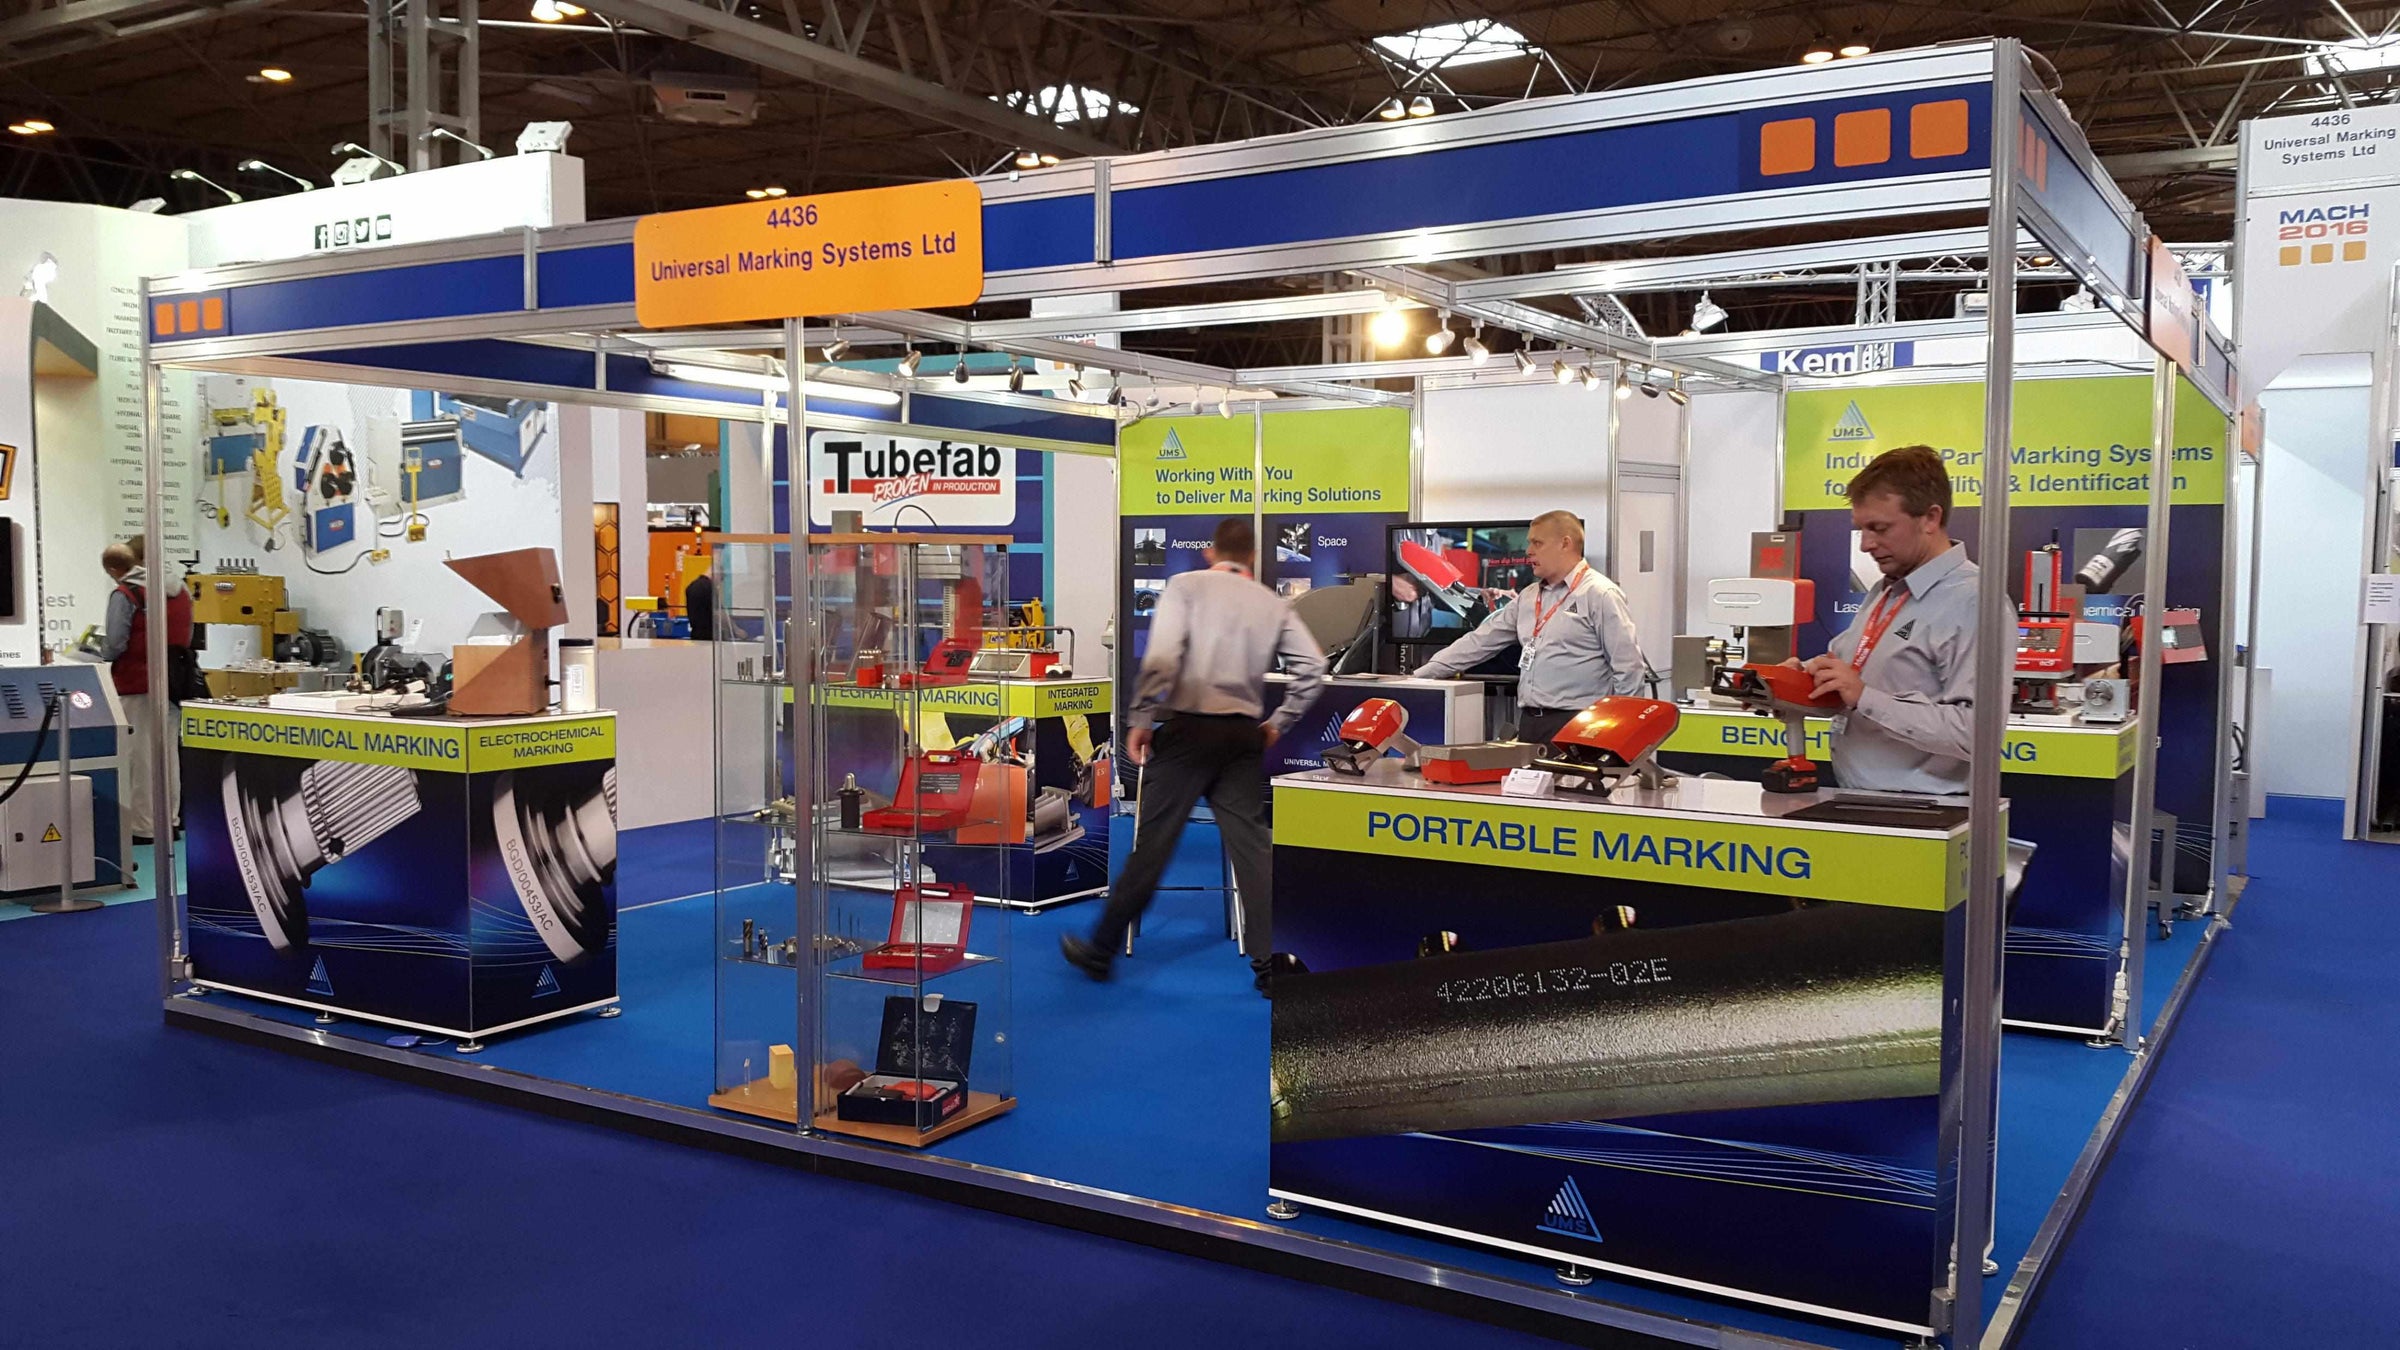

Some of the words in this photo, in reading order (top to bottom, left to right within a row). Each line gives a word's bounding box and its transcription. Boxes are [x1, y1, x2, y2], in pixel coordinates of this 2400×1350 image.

[2311, 114, 2351, 127] 4436
[2264, 134, 2330, 150] Universal
[2336, 128, 2396, 143] Marking
[2282, 149, 2346, 165] Systems
[2352, 144, 2376, 157] Ltd
[767, 204, 819, 229] 4436
[2280, 203, 2370, 224] MACH
[2279, 220, 2369, 240] 2016
[651, 254, 731, 282] Universal
[738, 249, 813, 271] Marking
[822, 240, 912, 267] Systems
[922, 231, 957, 256] Ltd
[1833, 427, 1864, 438] UMS
[1159, 448, 1181, 457] UMS
[824, 440, 1002, 494] Tubefab
[1155, 468, 1215, 485] Working
[1220, 466, 1253, 482] With
[1265, 466, 1294, 481] You
[873, 471, 932, 501] PROVEN
[932, 482, 943, 491] IN
[943, 482, 997, 491] PRODUCTION
[2030, 473, 2187, 493] Identificatn
[1156, 491, 1171, 505] to
[1175, 490, 1226, 504] Deliver
[1307, 487, 1382, 503] Solutions
[1317, 536, 1348, 549] Space
[921, 689, 999, 706] MARKING
[1048, 687, 1099, 699] INTEGRATED
[1054, 700, 1093, 711] MARKING
[186, 717, 359, 751] ELECTROCHEMICAL
[364, 732, 460, 760] MARKING
[480, 726, 605, 748] ELECTROCHEMICAL
[514, 742, 574, 758] MARKING
[1283, 757, 1322, 768] UNIVERSAL
[1368, 811, 1578, 857] PORTABLE
[1593, 829, 1812, 879] MARKING
[1436, 957, 1673, 1003] 42206132-02E
